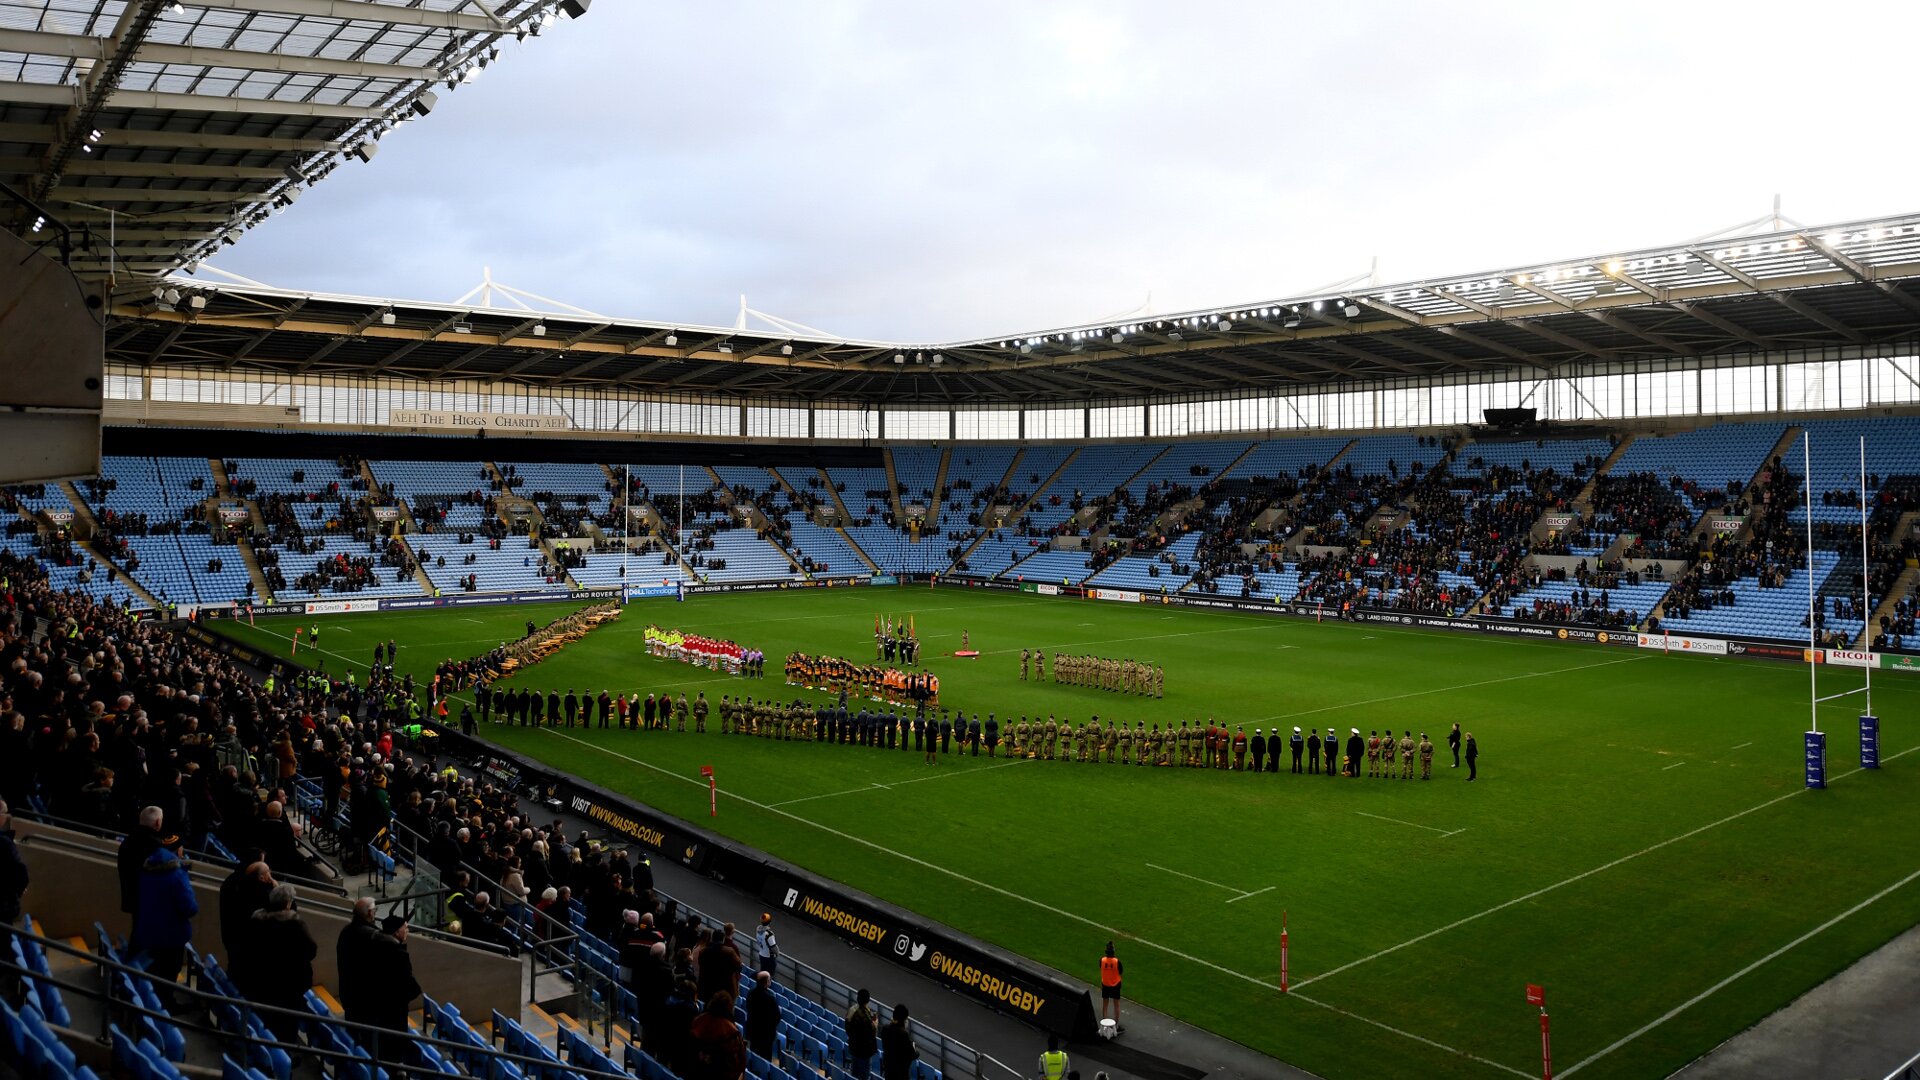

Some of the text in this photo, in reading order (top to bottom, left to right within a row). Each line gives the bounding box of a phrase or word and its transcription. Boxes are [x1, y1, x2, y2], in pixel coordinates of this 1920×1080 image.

[392, 413, 566, 428] AEH THE HIGGS CHARITY AEH
[324, 603, 342, 611] Smith
[360, 601, 377, 609] Smith
[250, 606, 288, 615] AND ROVER
[1568, 630, 1596, 638] SCUTUM
[1608, 633, 1637, 642] SCUTUM
[1648, 638, 1659, 646] DS
[1692, 641, 1702, 649] DS
[1702, 642, 1725, 652] Smith
[1833, 650, 1873, 661] RICOH
[571, 795, 591, 813] VISIT
[930, 951, 1045, 1016] @WASPSRUGBY
